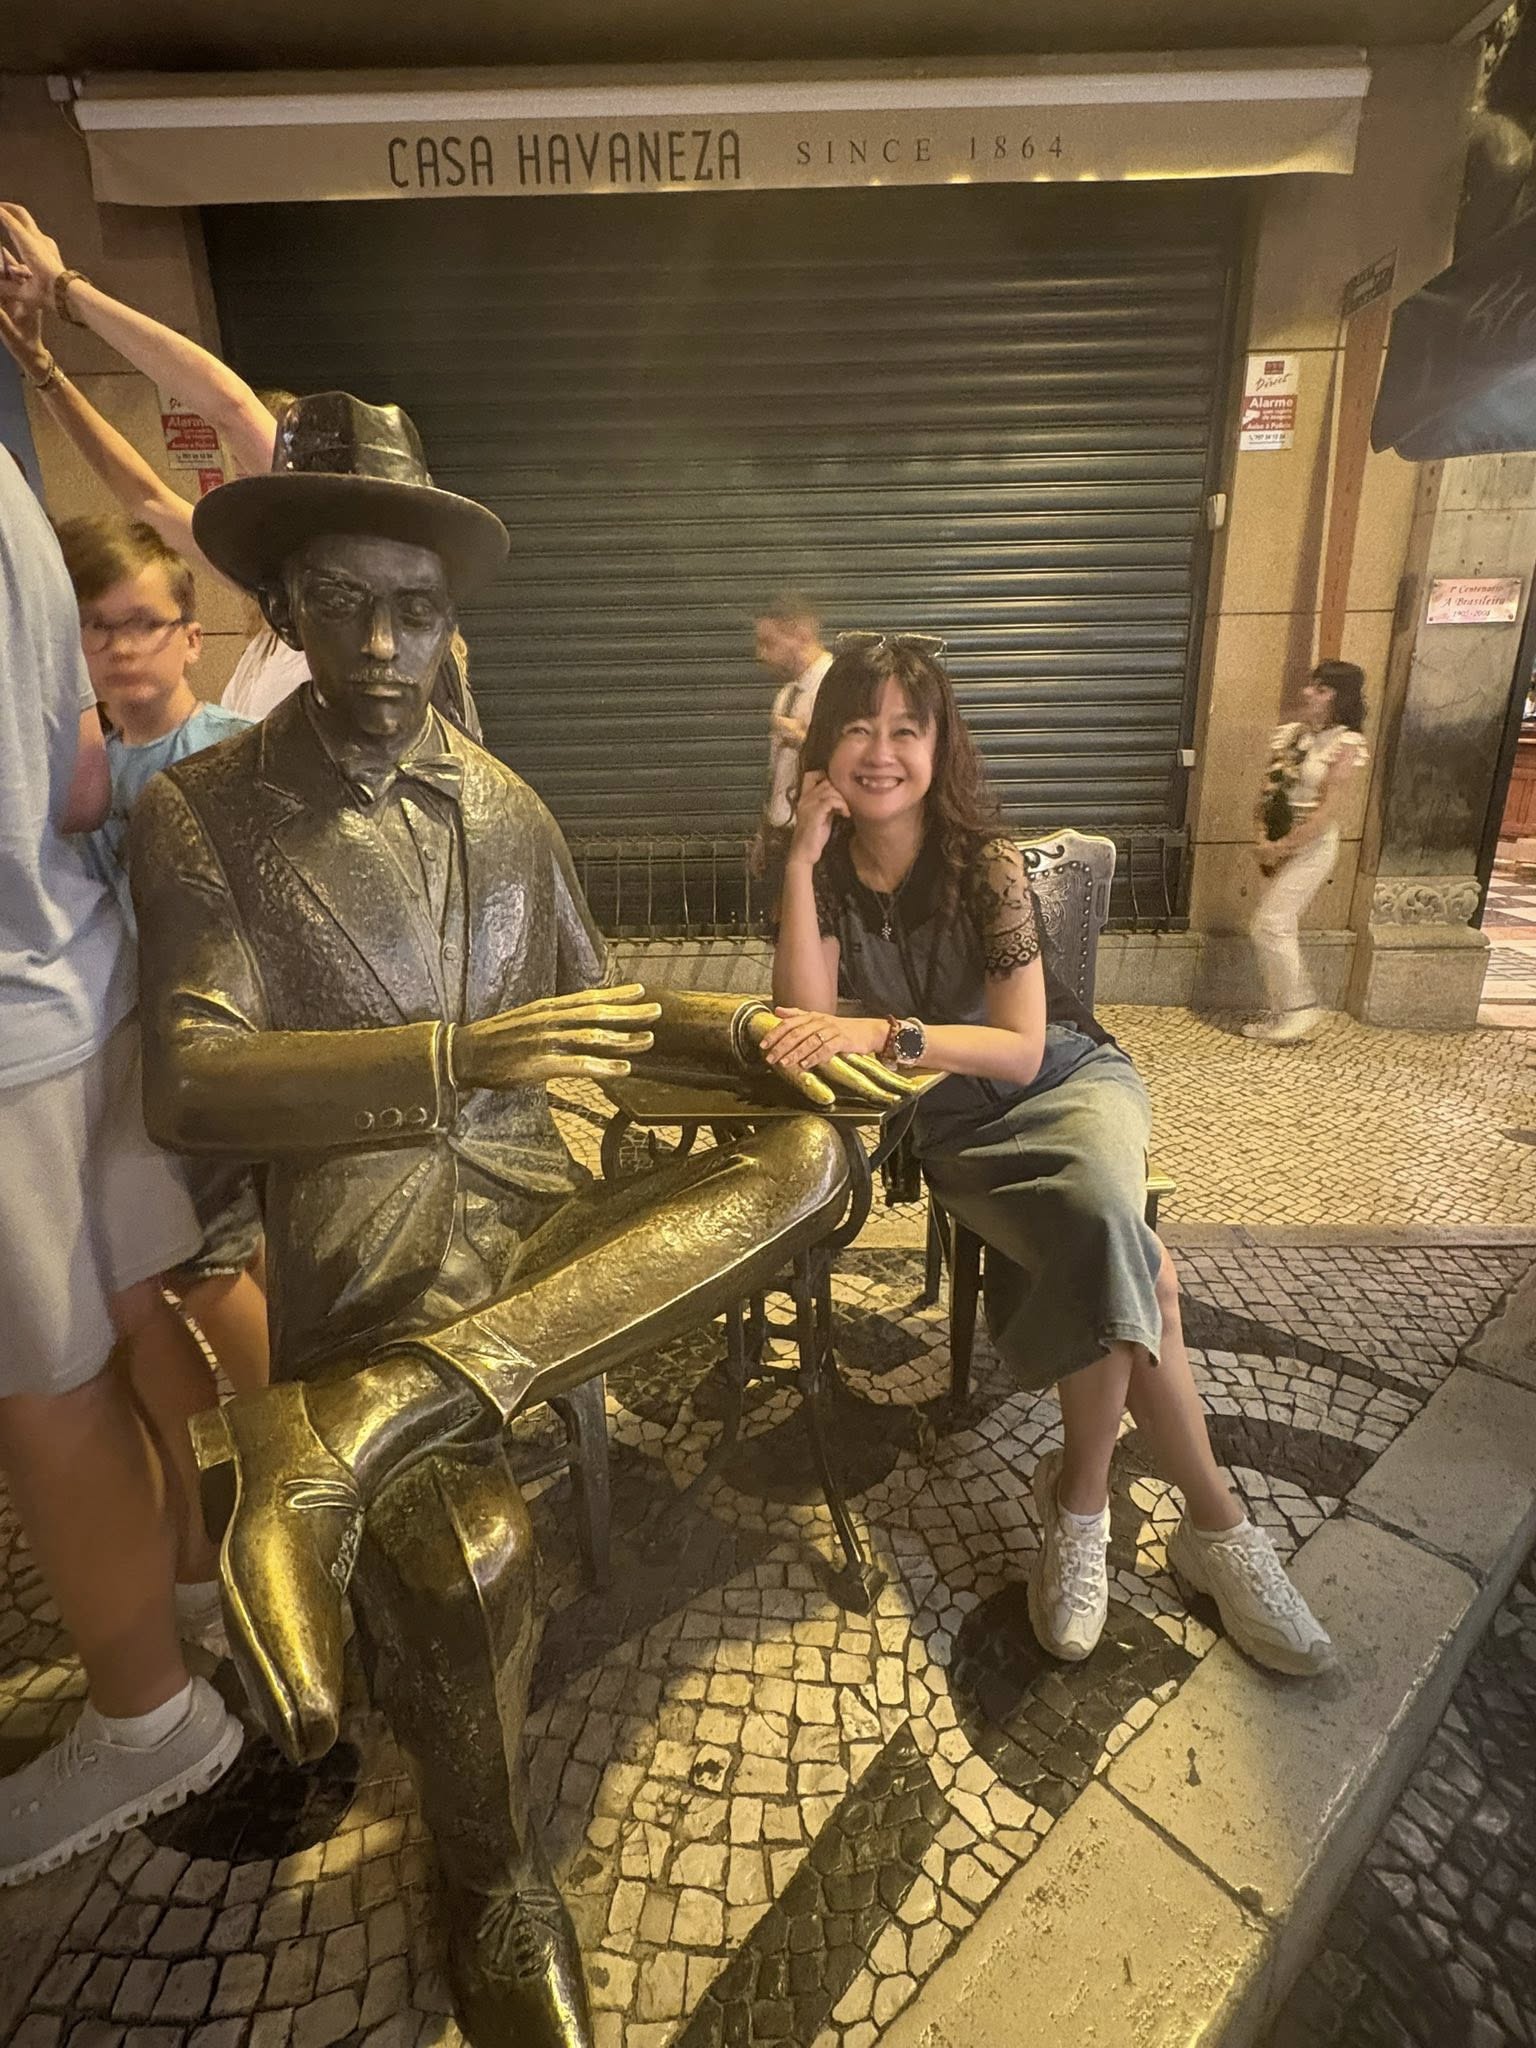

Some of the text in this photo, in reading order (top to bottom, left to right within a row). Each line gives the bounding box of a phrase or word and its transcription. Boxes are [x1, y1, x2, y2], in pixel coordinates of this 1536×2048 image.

[387, 129, 742, 189] CASA HAVANEZA
[796, 133, 1063, 165] SINCE 1864
[1249, 398, 1293, 408] Alarme
[1456, 595, 1505, 606] Brasileira
